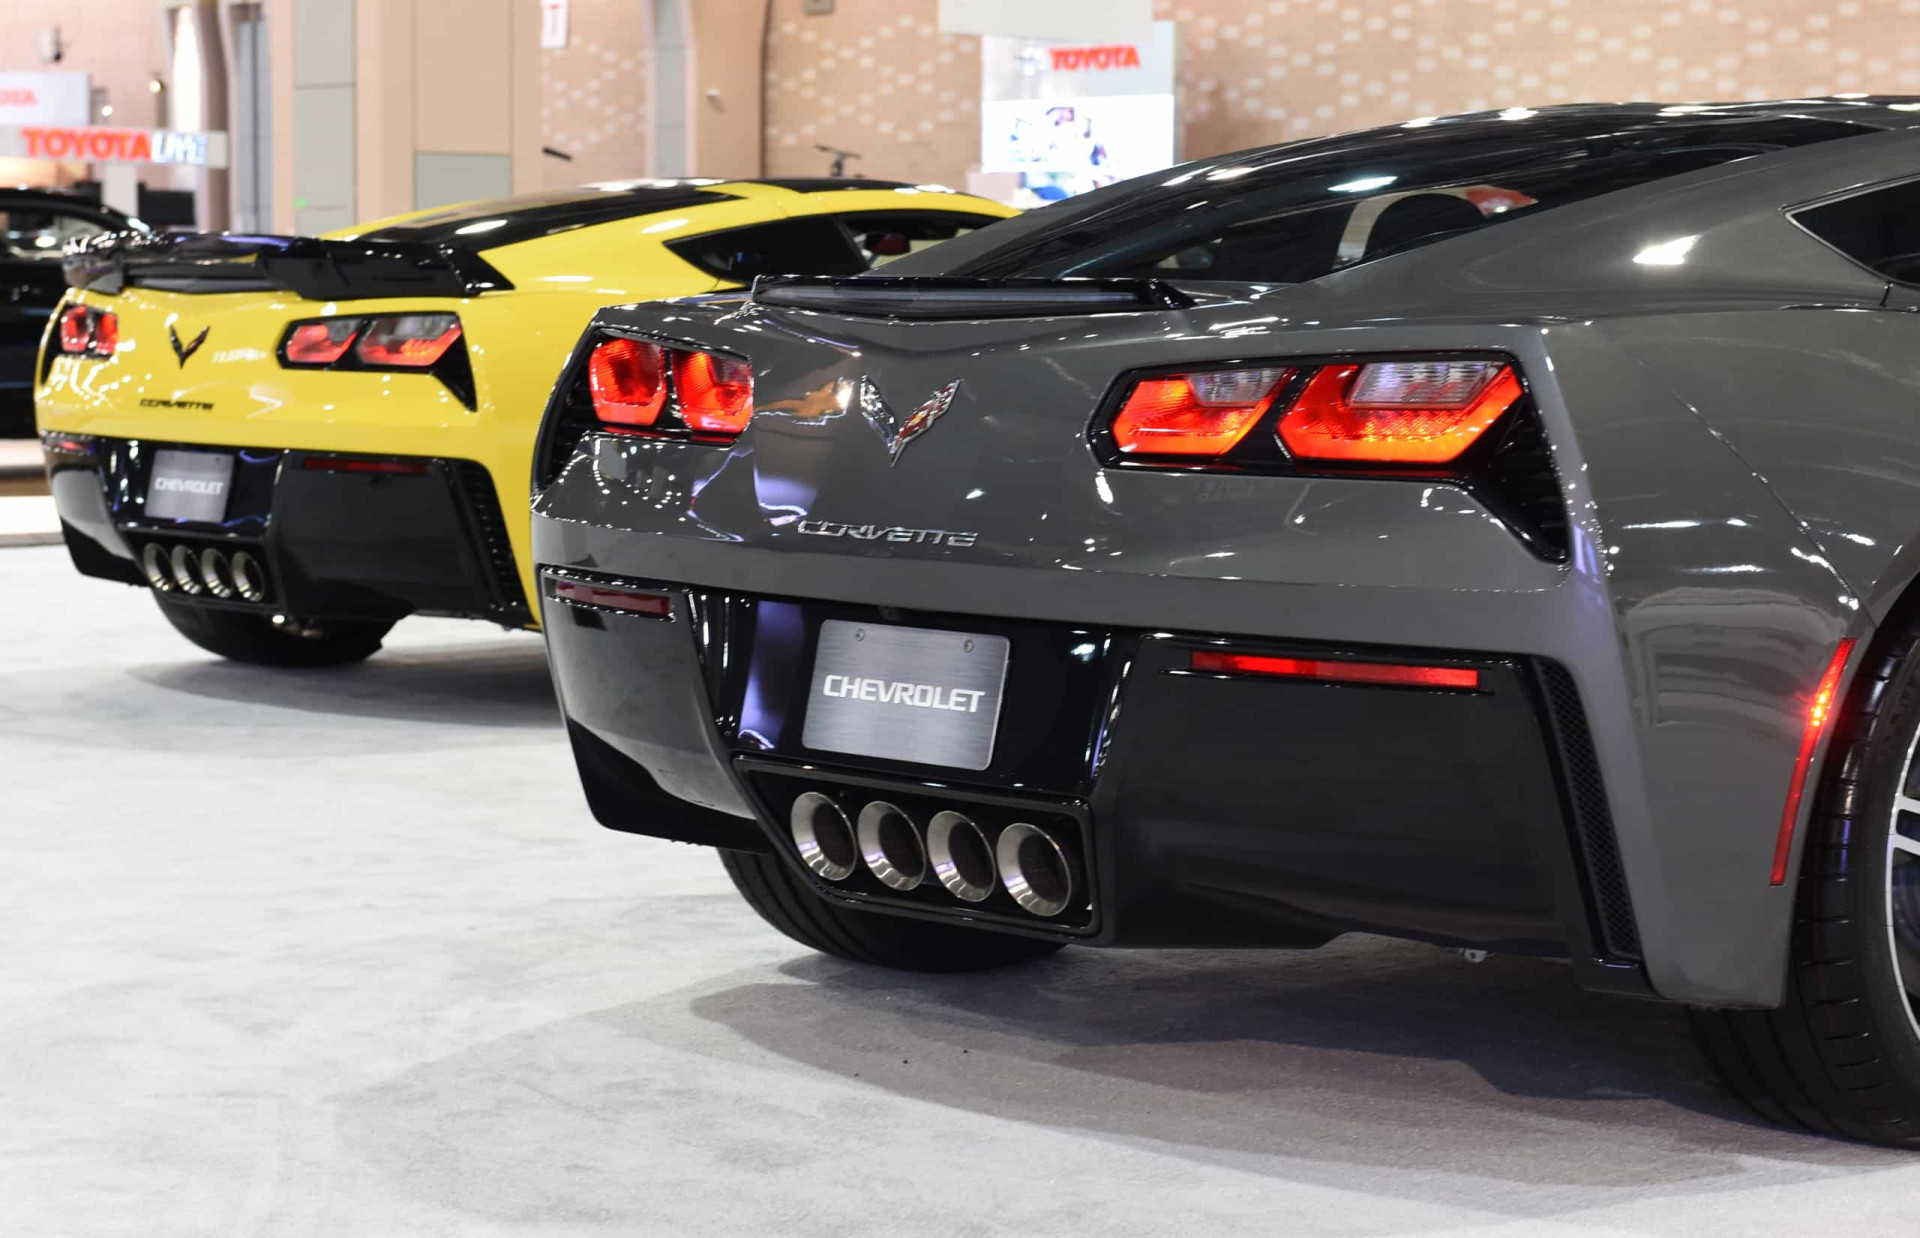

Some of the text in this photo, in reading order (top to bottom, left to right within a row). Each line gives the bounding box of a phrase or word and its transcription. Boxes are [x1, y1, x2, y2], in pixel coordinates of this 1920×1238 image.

[1049, 45, 1140, 70] TOYOTA
[139, 398, 215, 411] CORVETTE
[154, 477, 224, 495] CHEVROLET
[797, 520, 979, 547] CORVETTE
[822, 674, 986, 713] CHEVROLET
